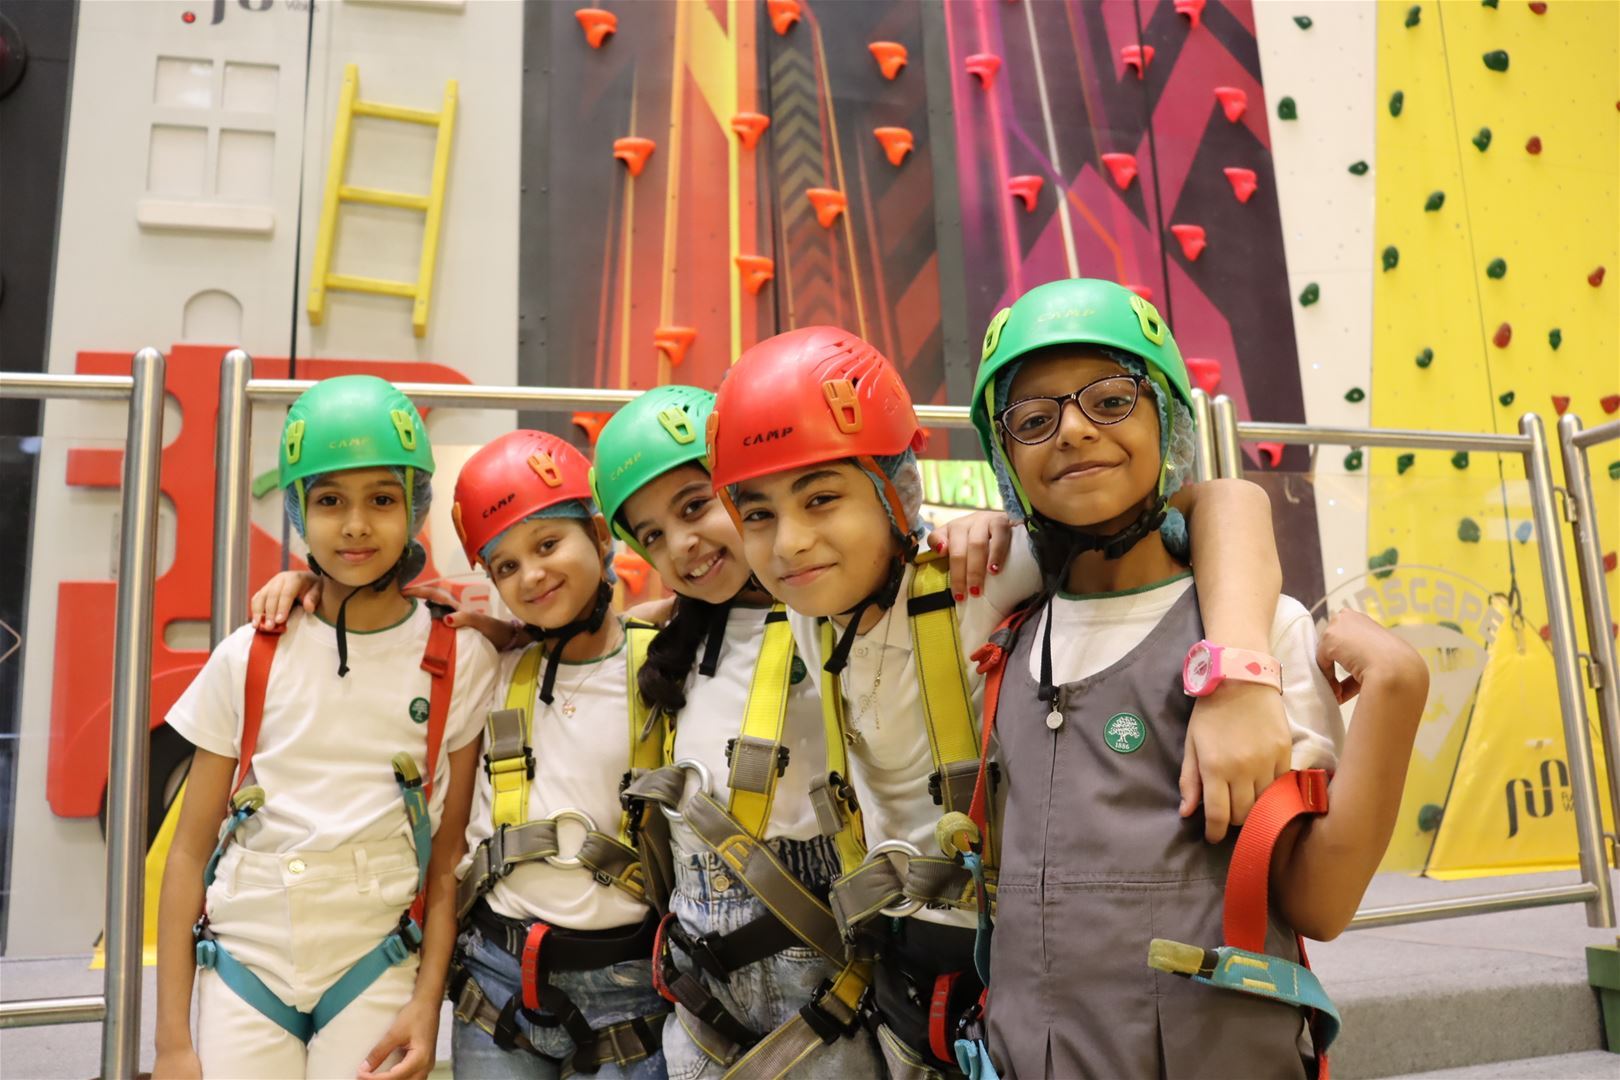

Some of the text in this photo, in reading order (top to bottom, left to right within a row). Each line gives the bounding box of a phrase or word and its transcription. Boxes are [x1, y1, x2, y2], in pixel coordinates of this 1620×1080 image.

[328, 436, 371, 449] CAMP
[743, 427, 793, 446] CAMP
[611, 451, 642, 480] CAMP
[482, 493, 516, 518] CAMP
